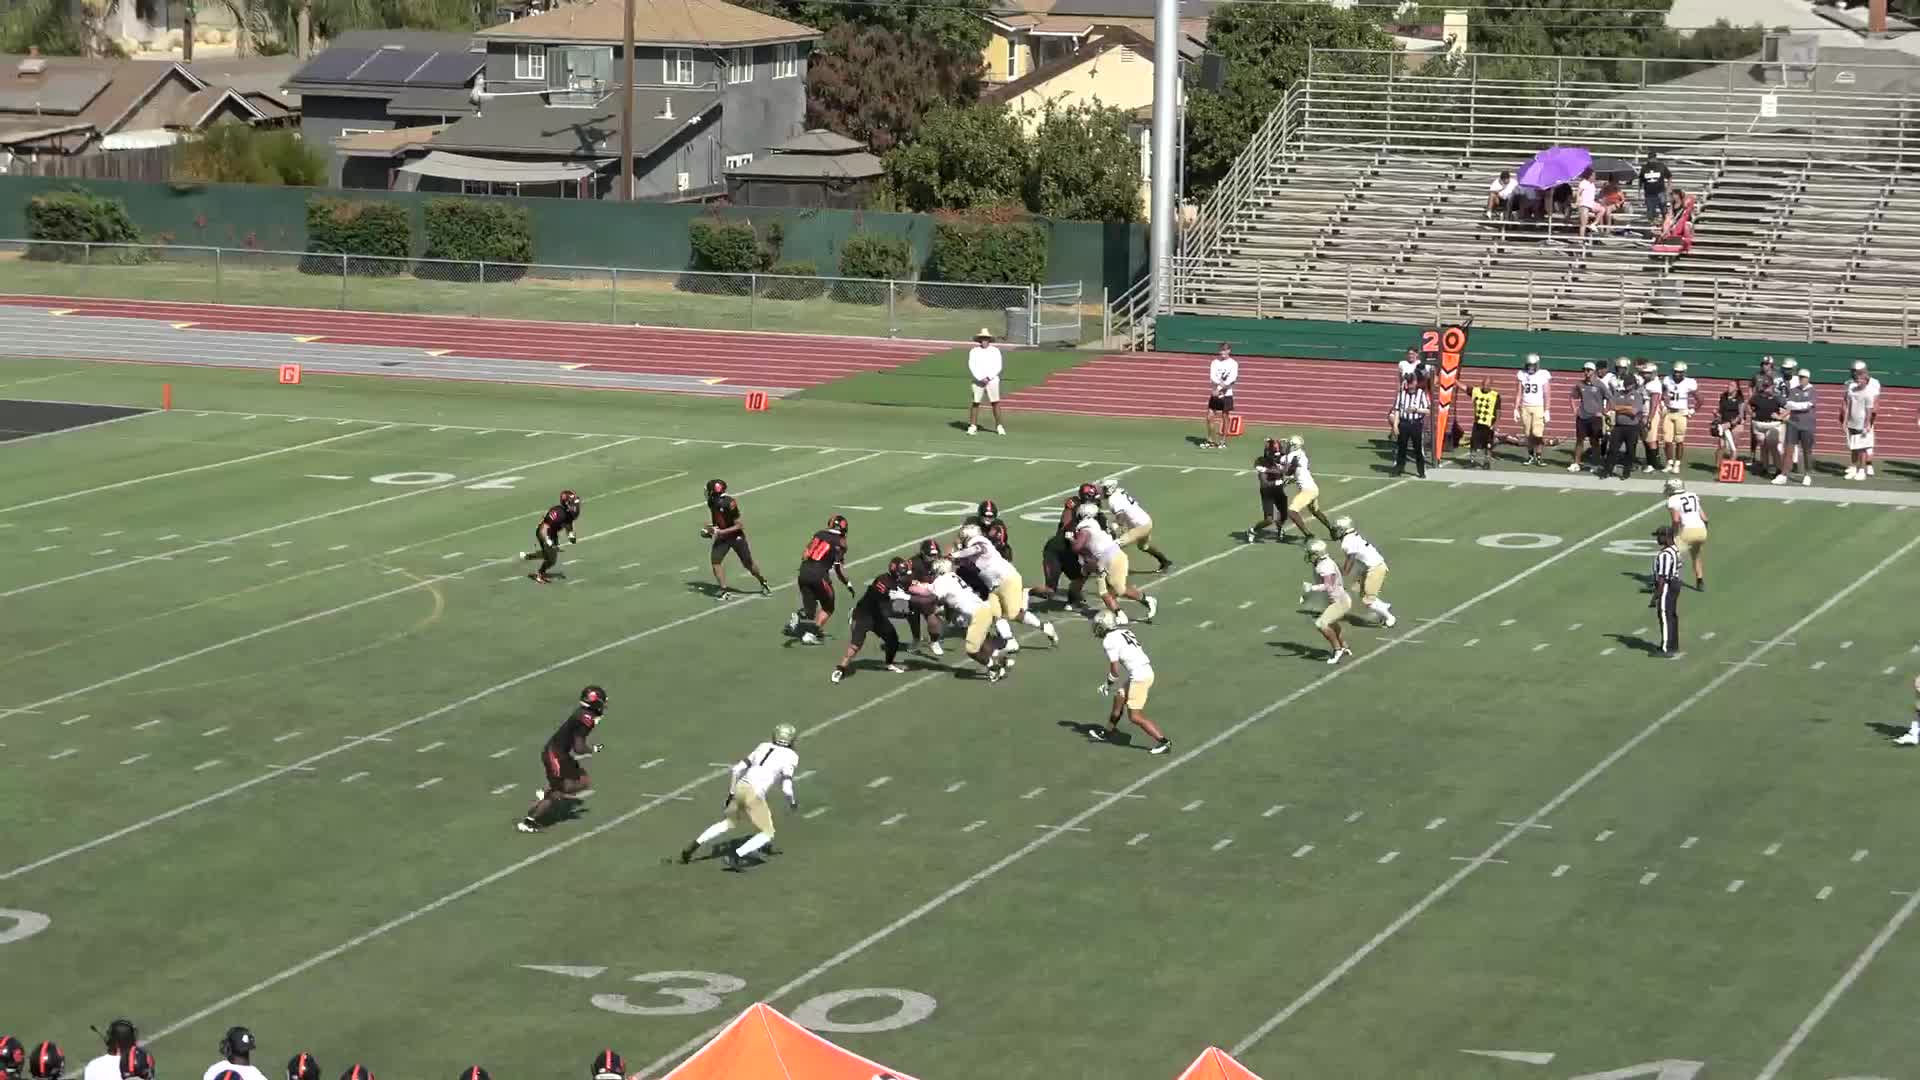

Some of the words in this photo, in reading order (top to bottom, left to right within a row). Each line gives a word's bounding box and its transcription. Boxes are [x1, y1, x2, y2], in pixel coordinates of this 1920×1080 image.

[747, 392, 763, 409] 10
[1721, 463, 1740, 480] 30
[1680, 495, 1697, 513] 27
[759, 747, 775, 766] 1
